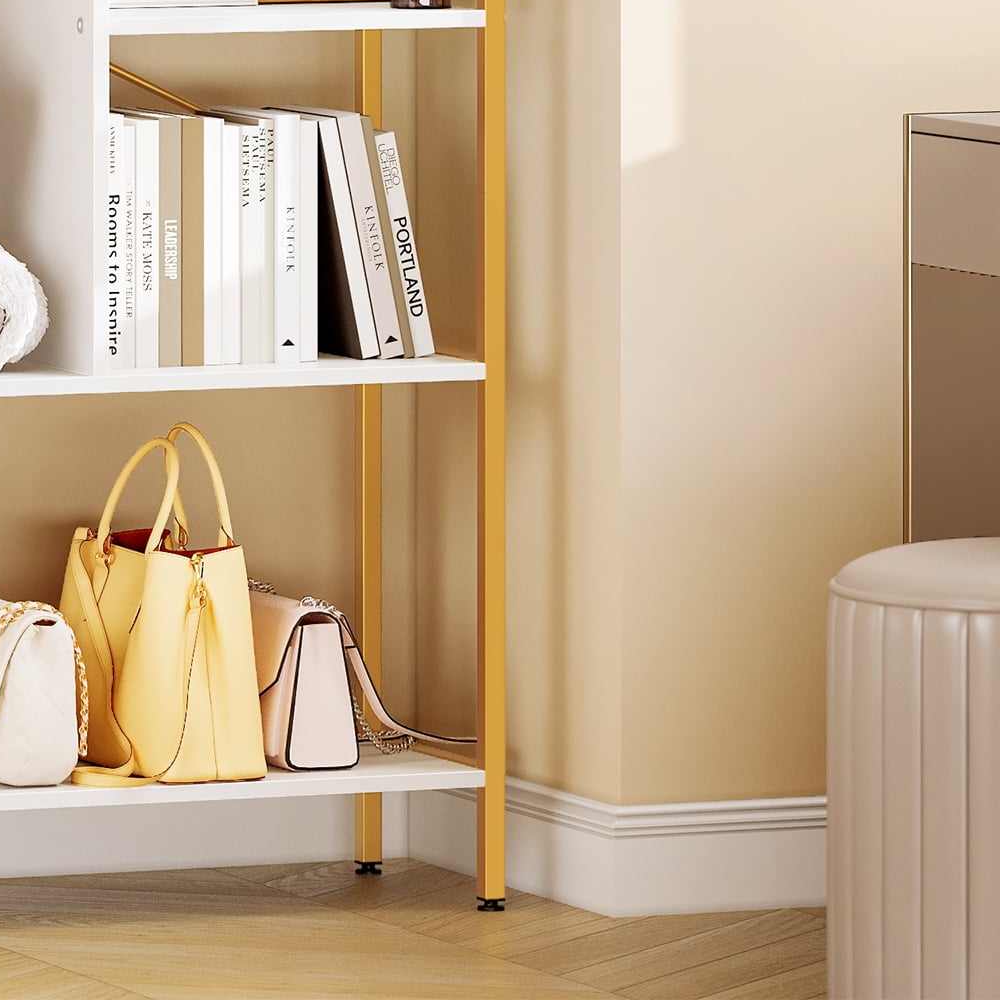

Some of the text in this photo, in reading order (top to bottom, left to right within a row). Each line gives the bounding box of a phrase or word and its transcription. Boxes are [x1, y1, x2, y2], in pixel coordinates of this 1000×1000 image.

[242, 134, 250, 207] SIETSEMA
[386, 147, 401, 186] DIEGO
[108, 194, 120, 258] Rooms
[125, 190, 133, 318] TIM WALKER STORY TELLER
[142, 212, 152, 291] KATE MOSS
[164, 218, 178, 280] LEADERSHIP
[286, 206, 295, 273] KINFOLK
[364, 205, 385, 271] KINFOLK
[108, 264, 120, 284] to
[393, 216, 424, 318] PORTLAND
